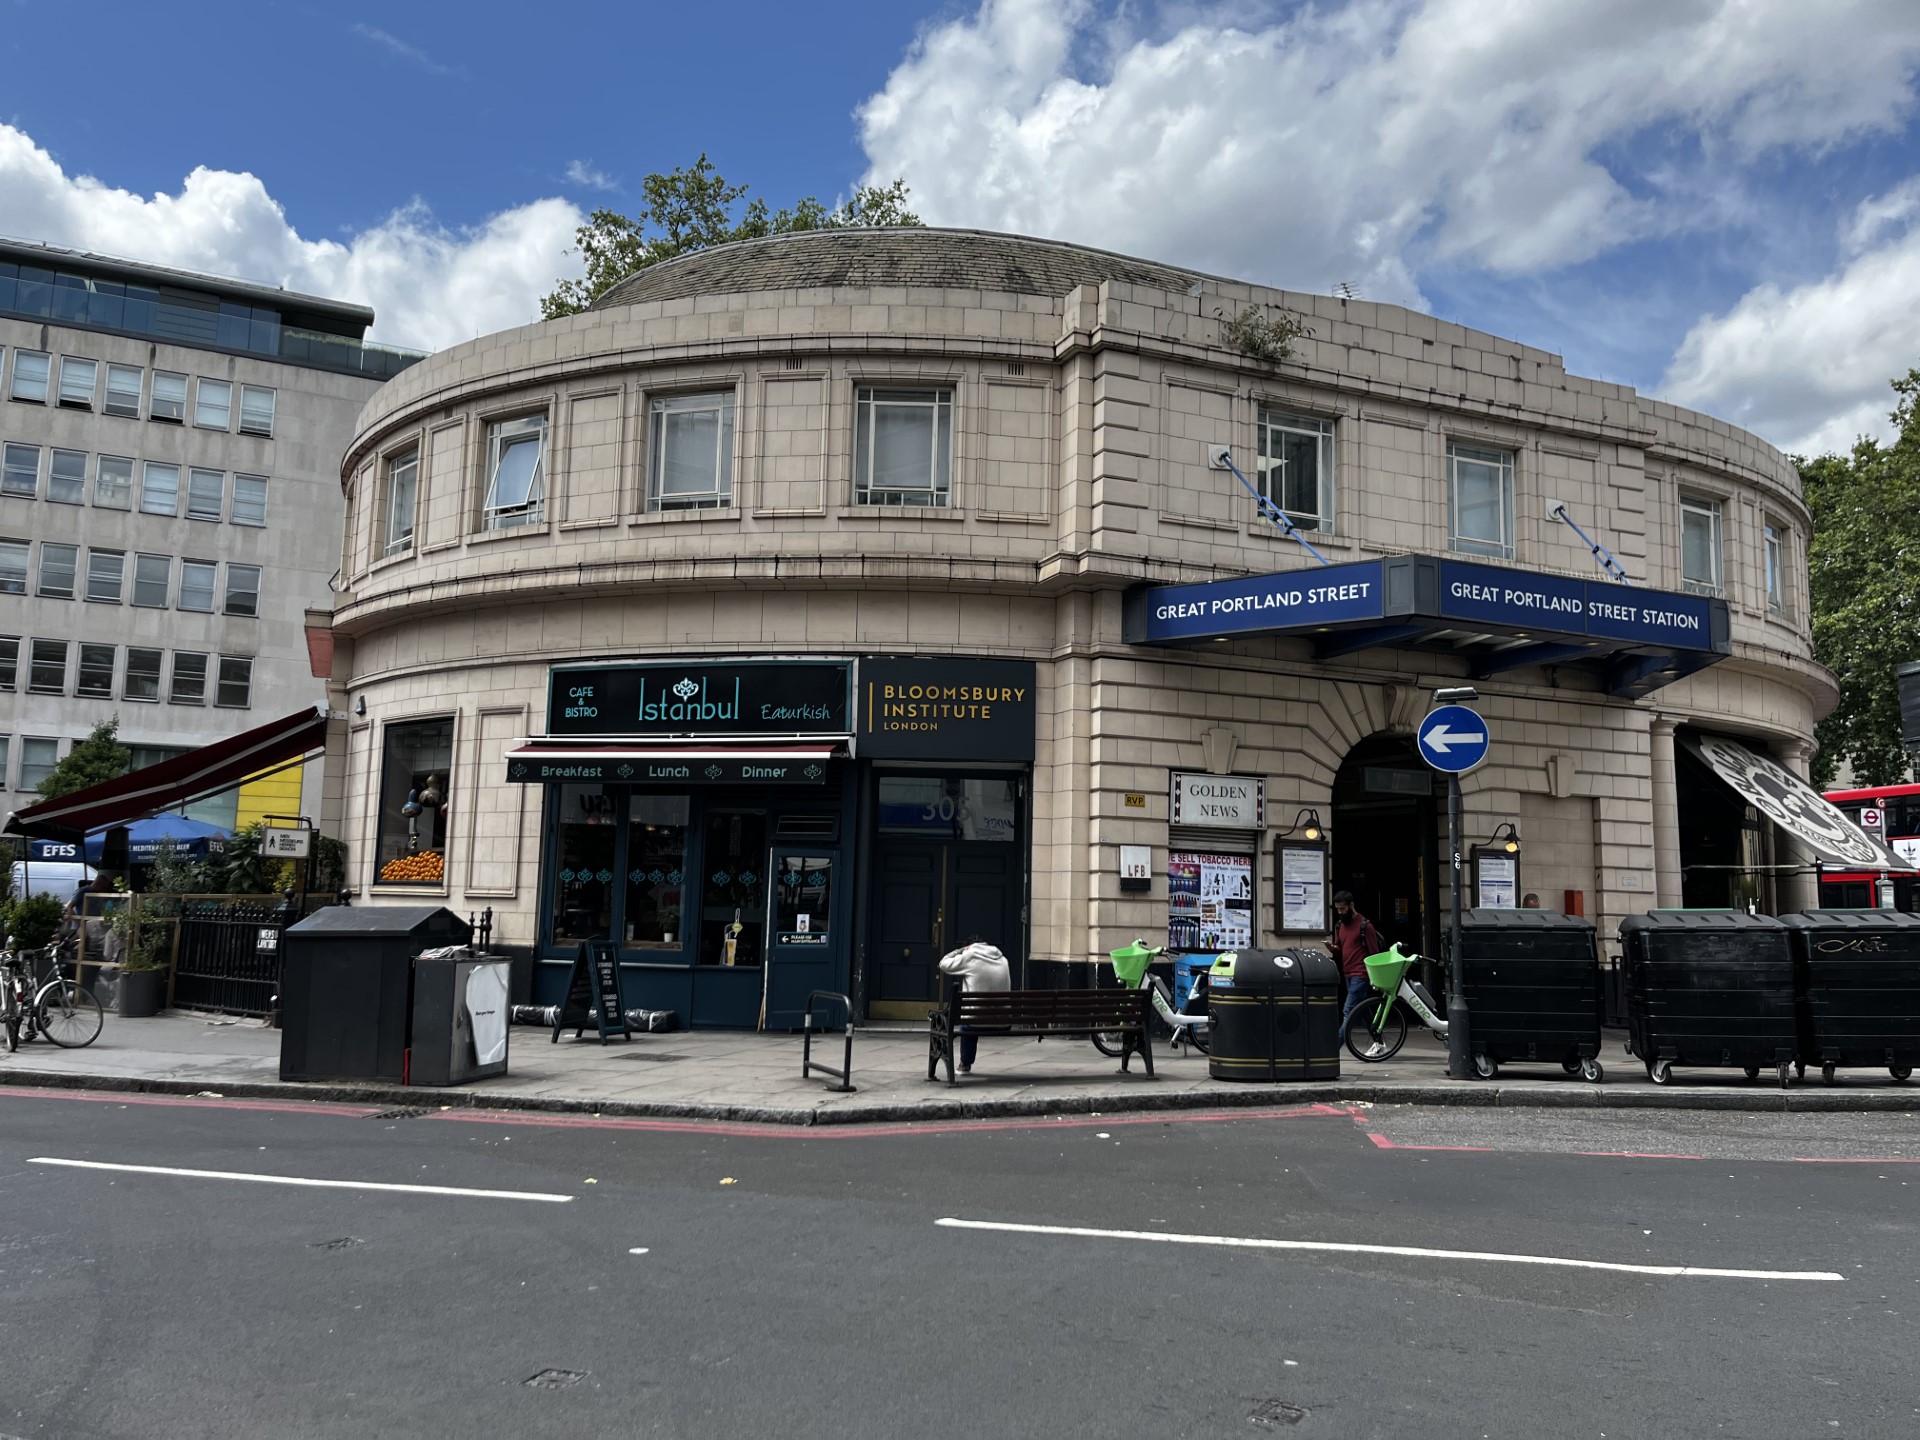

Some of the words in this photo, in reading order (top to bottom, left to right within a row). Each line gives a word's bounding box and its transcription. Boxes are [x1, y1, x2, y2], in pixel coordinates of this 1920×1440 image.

[1156, 601, 1207, 619] GREAT
[1212, 591, 1302, 614] PORTLAND
[1308, 583, 1370, 604] STREET
[1451, 582, 1499, 602] GREAT
[1505, 589, 1582, 613] PORTLAND
[1588, 602, 1636, 621] STREET
[1642, 610, 1698, 630] STATION
[569, 687, 594, 698] CAFE
[638, 677, 740, 720] Istanbul
[884, 685, 1025, 702] BLOOMSBURY
[578, 698, 585, 706] &
[565, 706, 598, 718] BISTRO
[761, 704, 831, 720] Eaturkish
[884, 704, 991, 719] INSTITUTE
[884, 722, 938, 731] LONDON
[541, 765, 602, 777] Breakfast
[649, 765, 690, 778] Lunch
[742, 766, 788, 778] Dinner
[1190, 784, 1248, 799] GOLDEN
[1127, 796, 1144, 805] RVP
[1200, 804, 1239, 818] NEWS
[42, 844, 76, 857] EFES
[1178, 853, 1195, 863] SELL
[1197, 855, 1231, 865] TOBACCO
[1234, 857, 1251, 866] HERE
